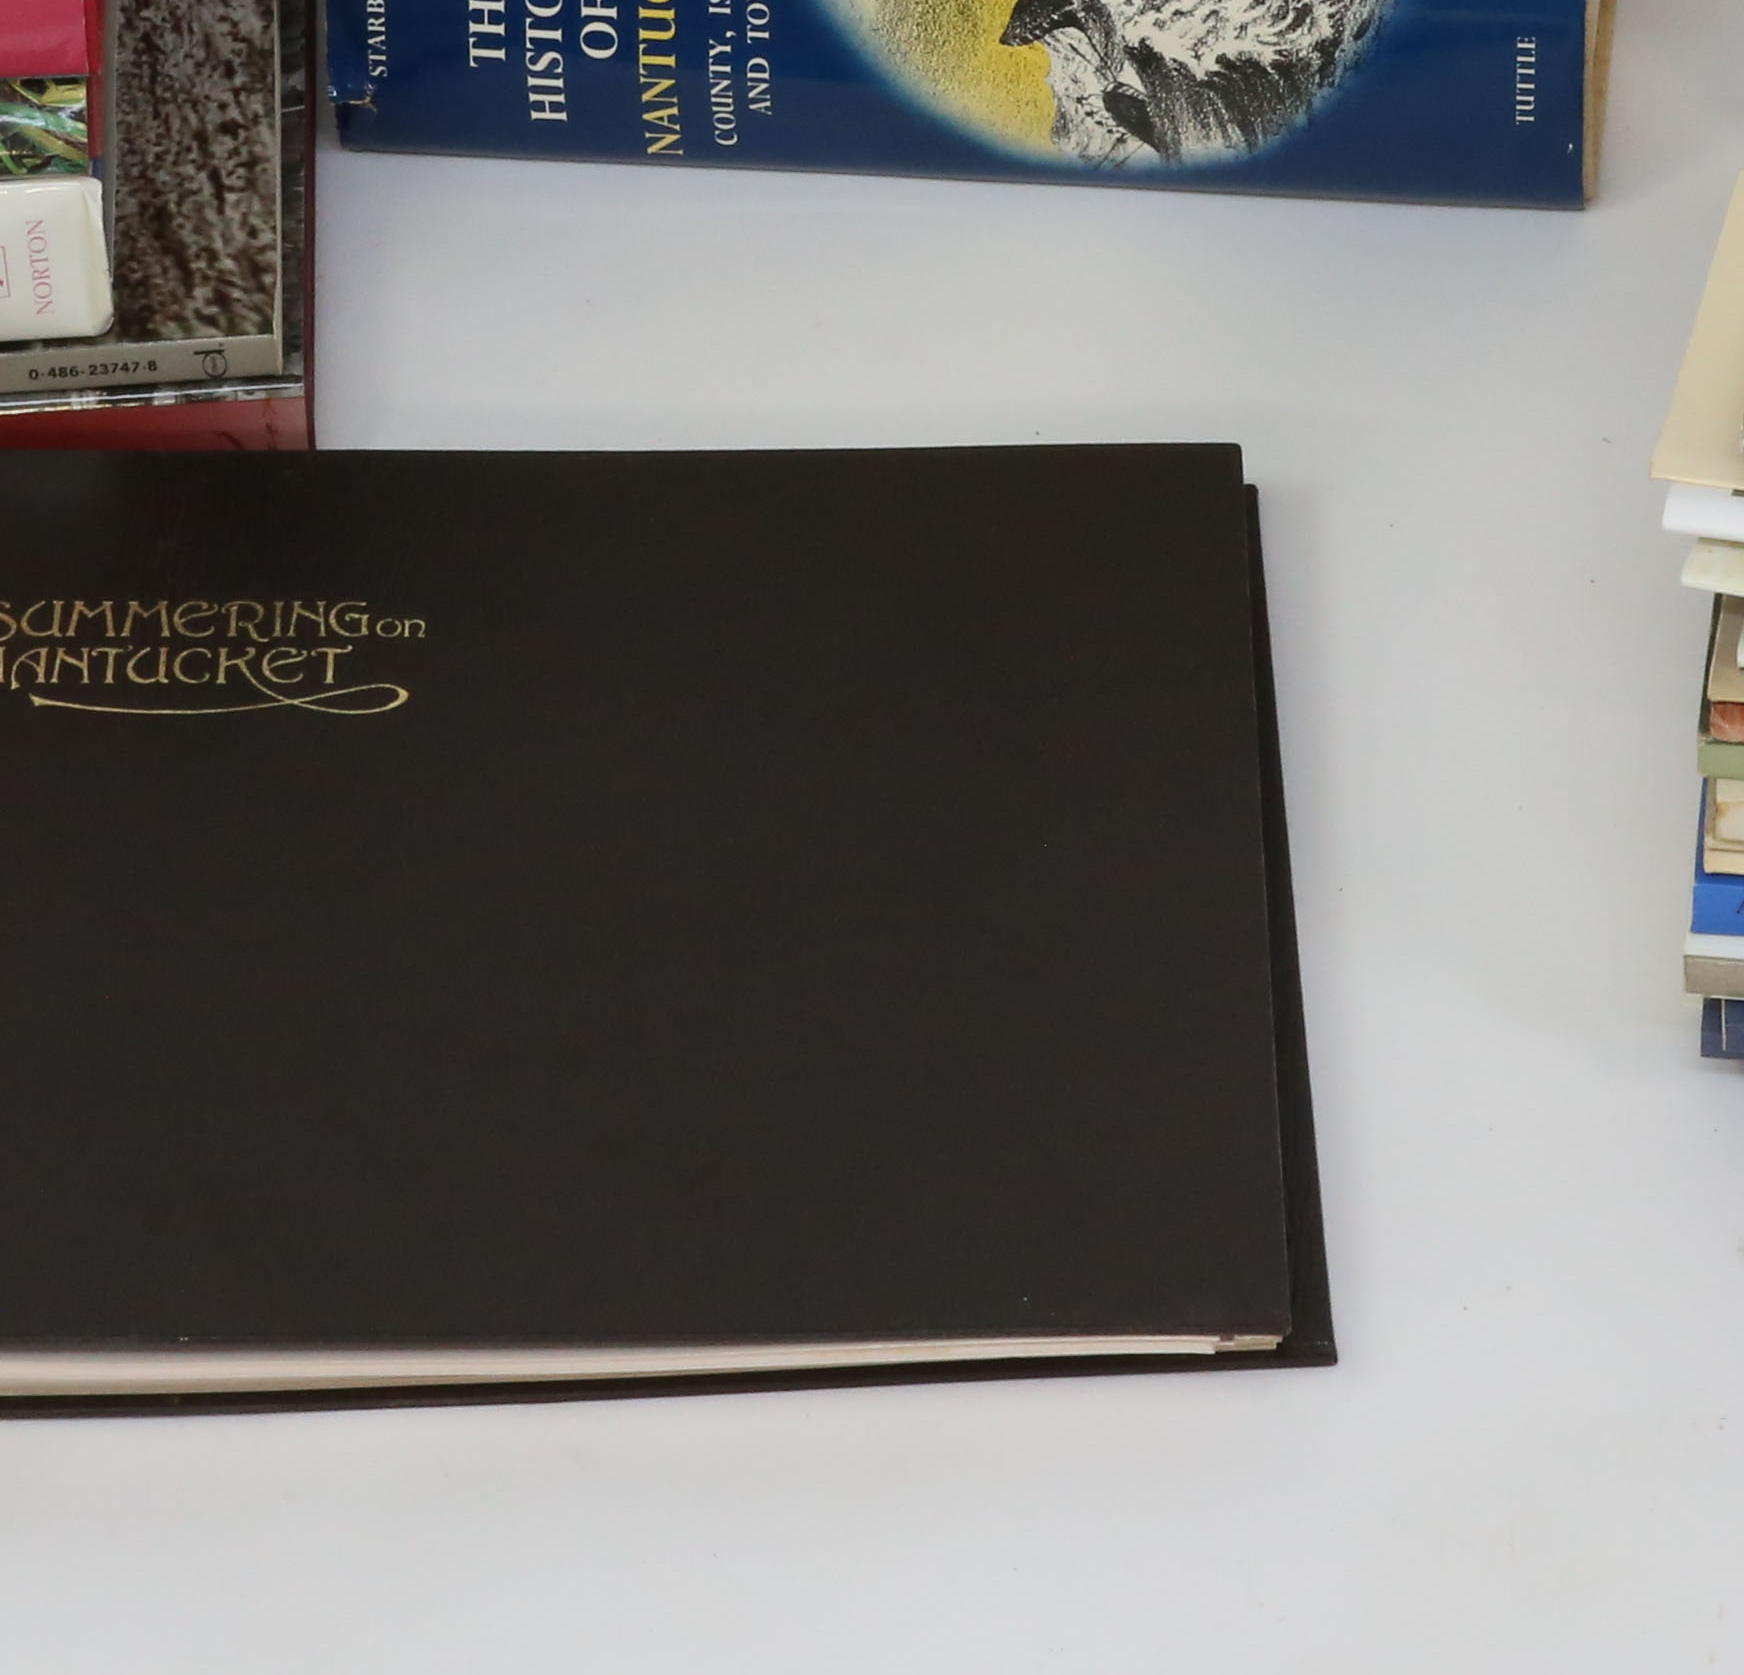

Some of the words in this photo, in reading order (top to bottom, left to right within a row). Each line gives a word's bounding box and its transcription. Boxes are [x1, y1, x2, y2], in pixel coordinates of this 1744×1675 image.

[706, 28, 740, 147] COUNTY,
[745, 62, 772, 117] AND
[1514, 34, 1538, 126] TUTTLE
[24, 218, 56, 316] NORTON
[375, 614, 427, 639] on
